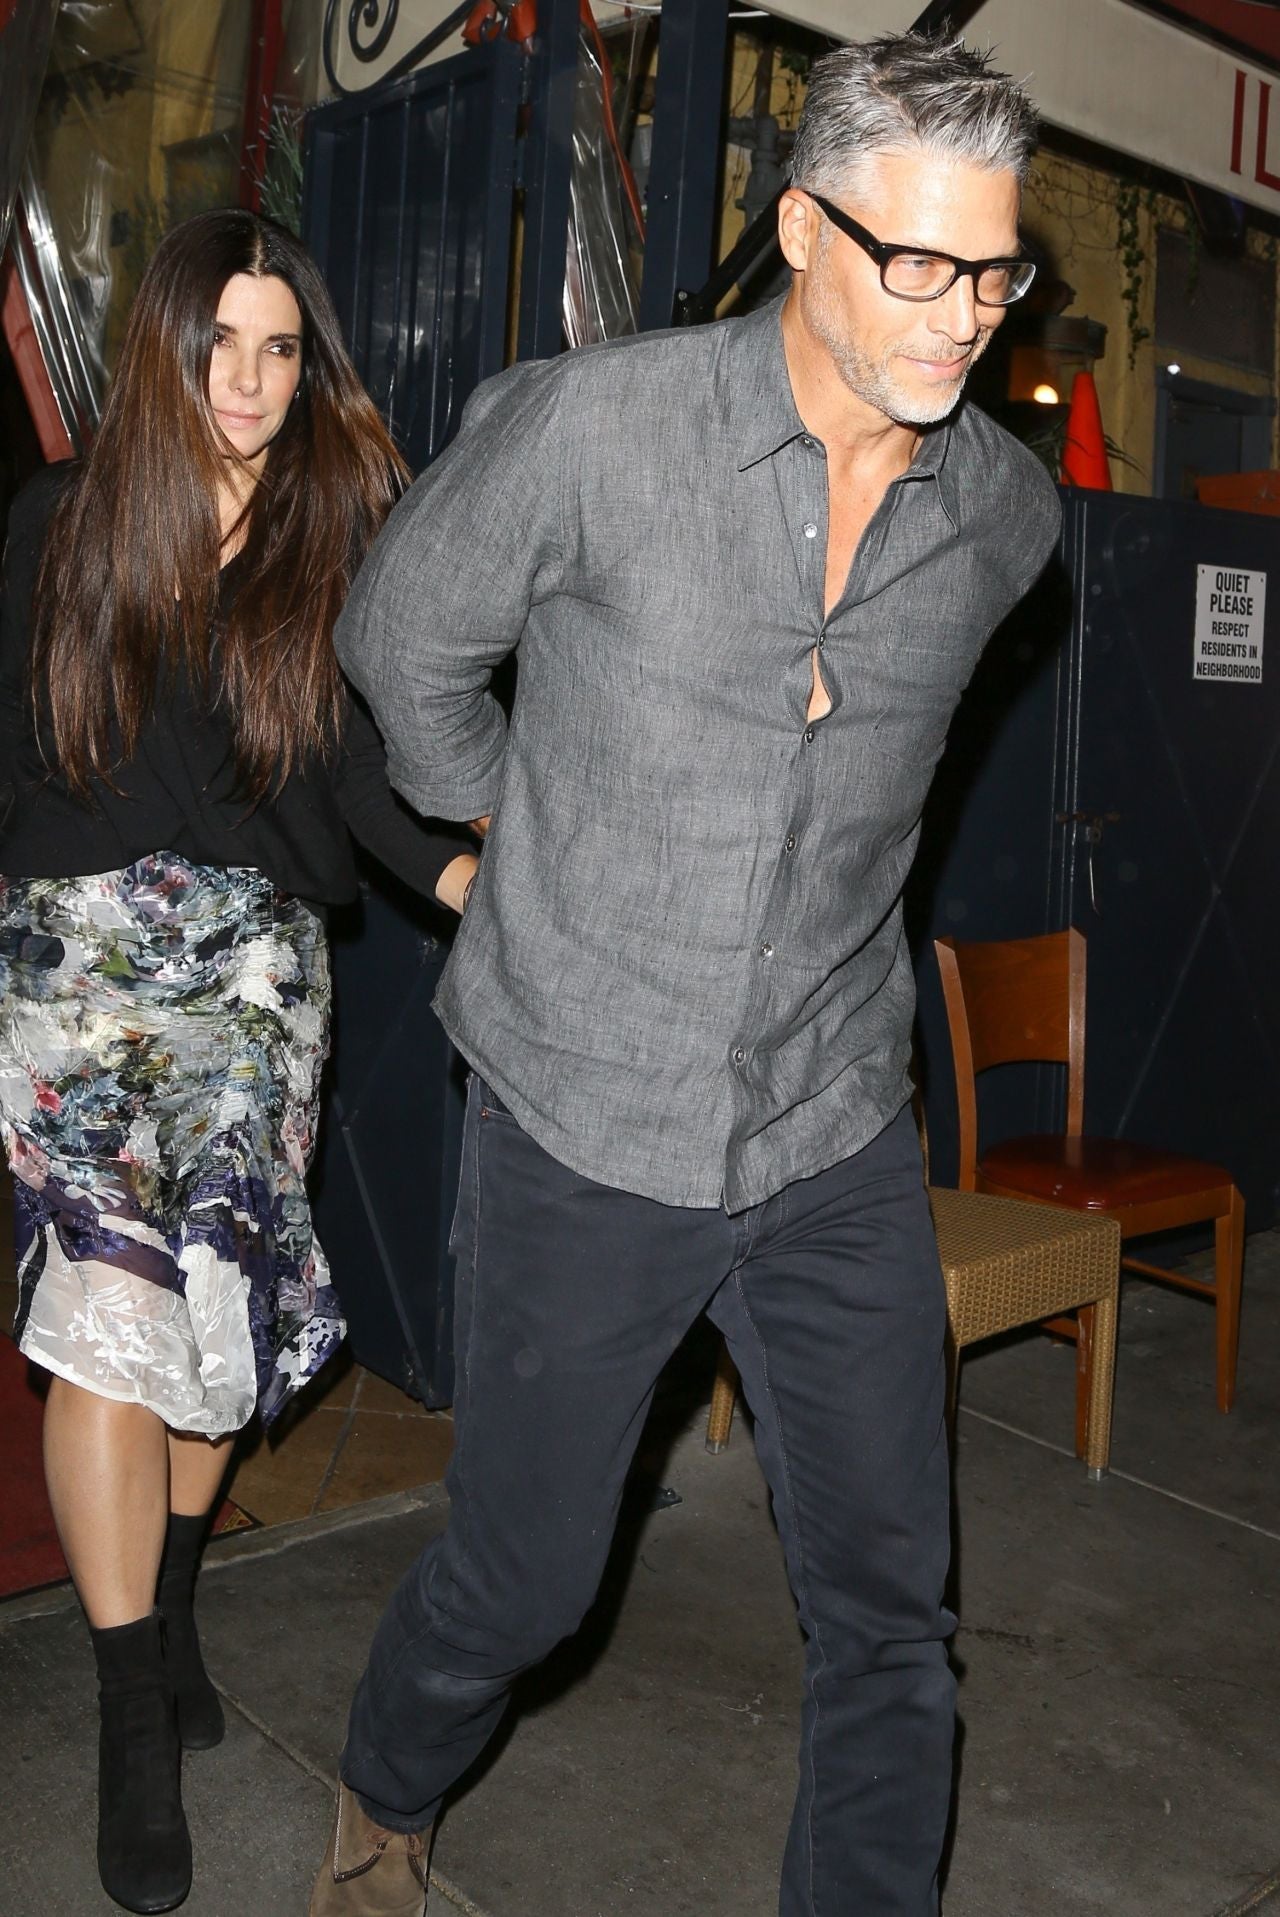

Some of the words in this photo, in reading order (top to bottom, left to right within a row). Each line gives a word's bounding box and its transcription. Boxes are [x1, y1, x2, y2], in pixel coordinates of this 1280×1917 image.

[1215, 572, 1250, 593] QUIET
[1210, 593, 1253, 616] PLEASE
[1212, 621, 1249, 638] RESPECT
[1201, 641, 1247, 658] RESIDENTS
[1249, 645, 1258, 659] IN
[1196, 662, 1261, 679] NEIGHBORHOOD
